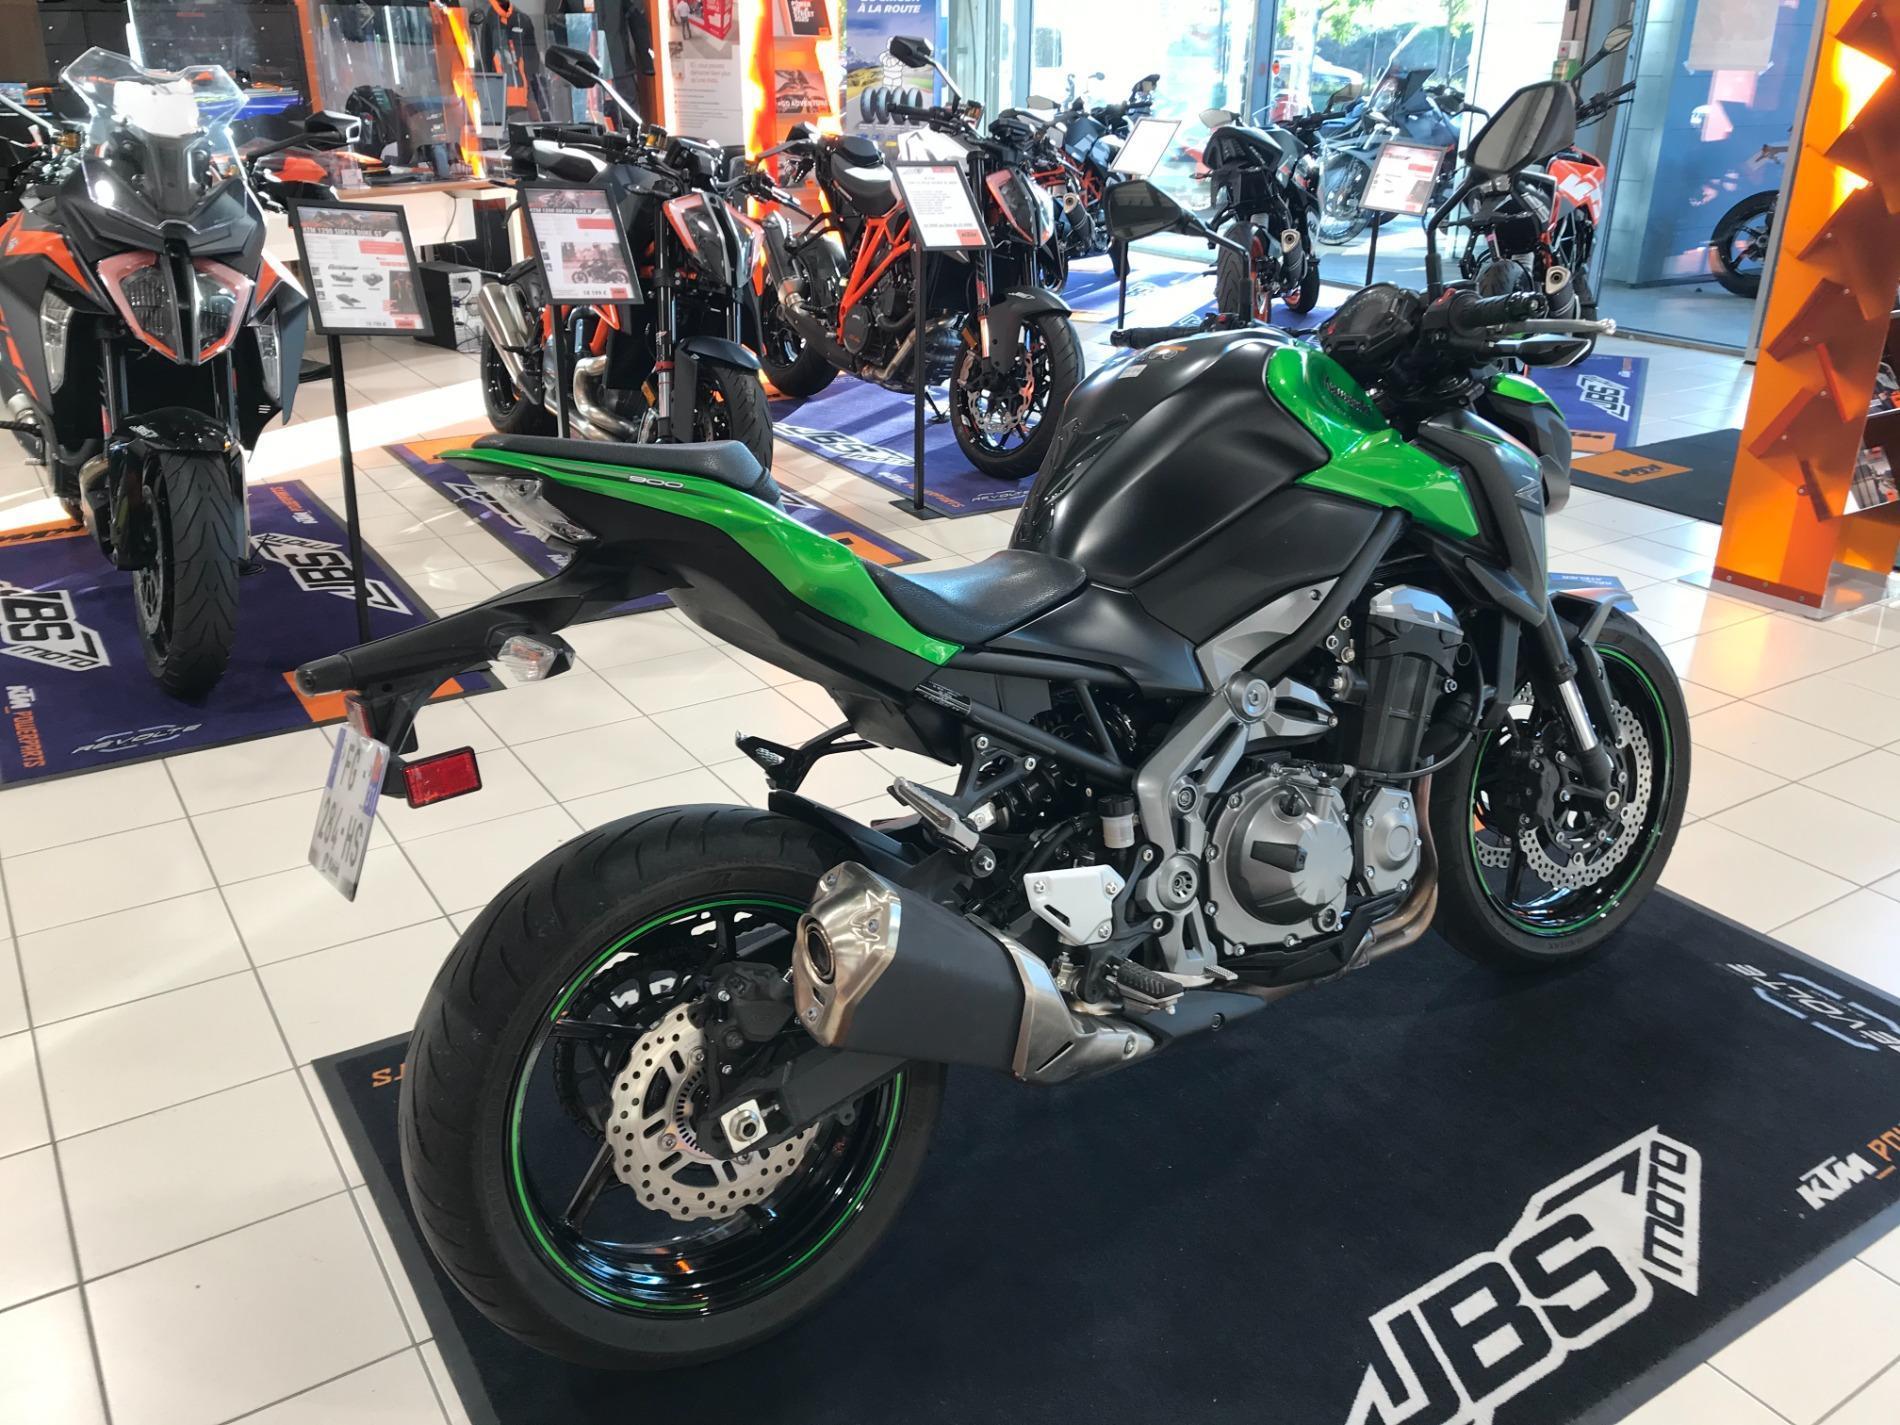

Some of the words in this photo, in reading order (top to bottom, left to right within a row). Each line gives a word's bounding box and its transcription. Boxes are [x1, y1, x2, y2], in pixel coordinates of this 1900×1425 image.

[857, 2, 866, 13] À
[868, 4, 882, 13] LA
[884, 4, 921, 14] ROUTE
[628, 475, 684, 489] 900
[11, 645, 101, 668] MOTO
[6, 685, 36, 709] KTM
[317, 796, 364, 868] 284-HS
[1795, 1152, 1878, 1211] KTM
[1642, 1140, 1688, 1278] MOTO
[1355, 1213, 1637, 1425] JBS
